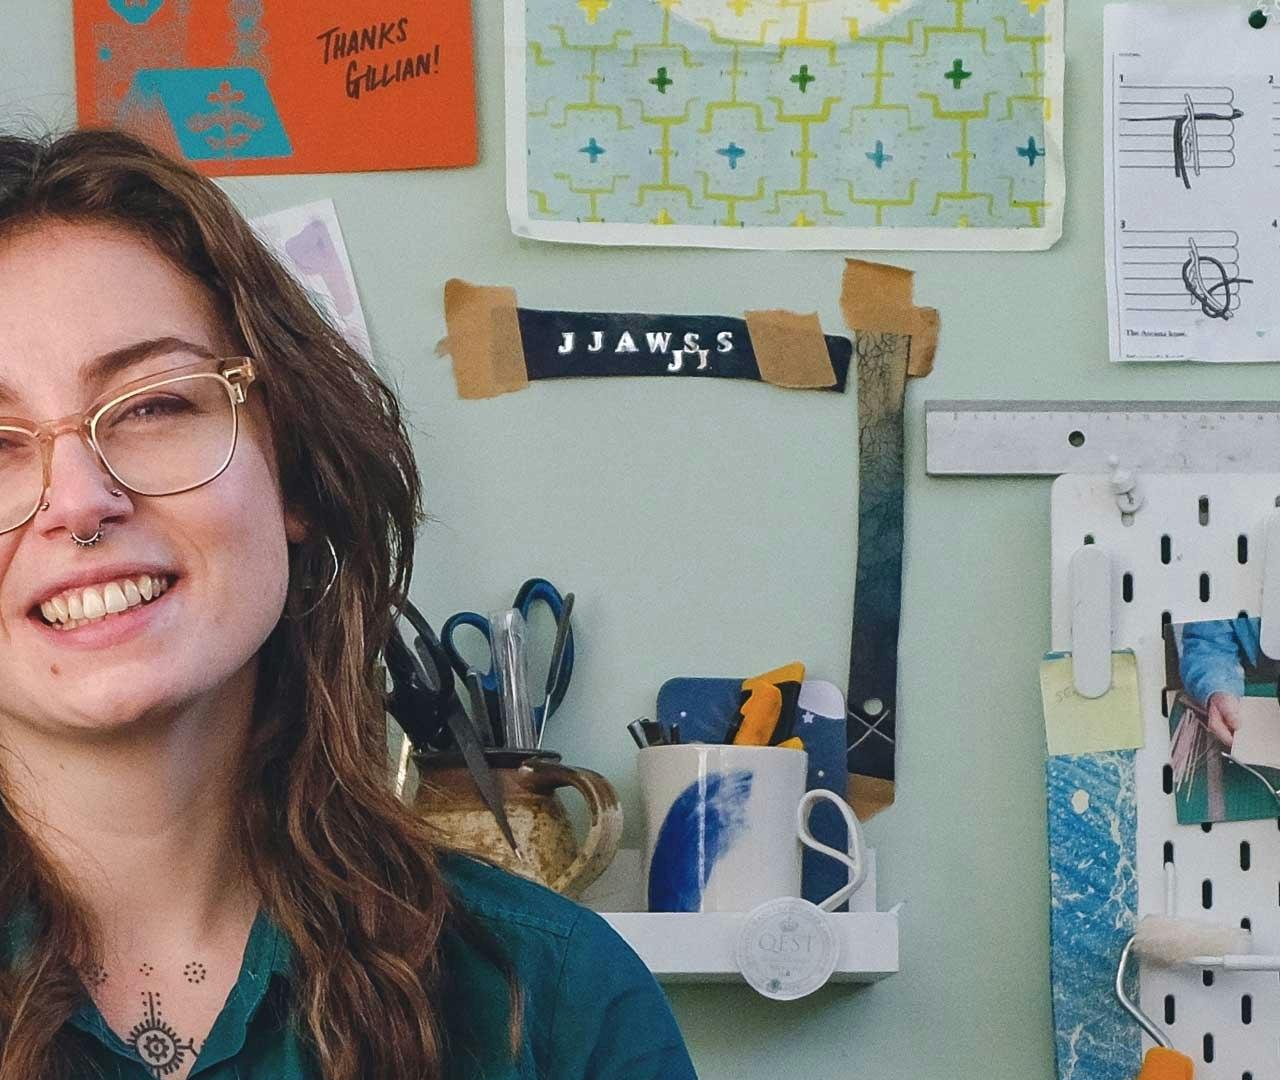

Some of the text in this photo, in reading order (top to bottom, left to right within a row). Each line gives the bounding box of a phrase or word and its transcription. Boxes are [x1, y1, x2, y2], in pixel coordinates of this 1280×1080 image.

[316, 17, 408, 64] THANKS
[345, 44, 440, 99] GILLIAN!
[1268, 75, 1274, 83] 2
[1120, 219, 1126, 229] 3
[1271, 218, 1278, 228] 4
